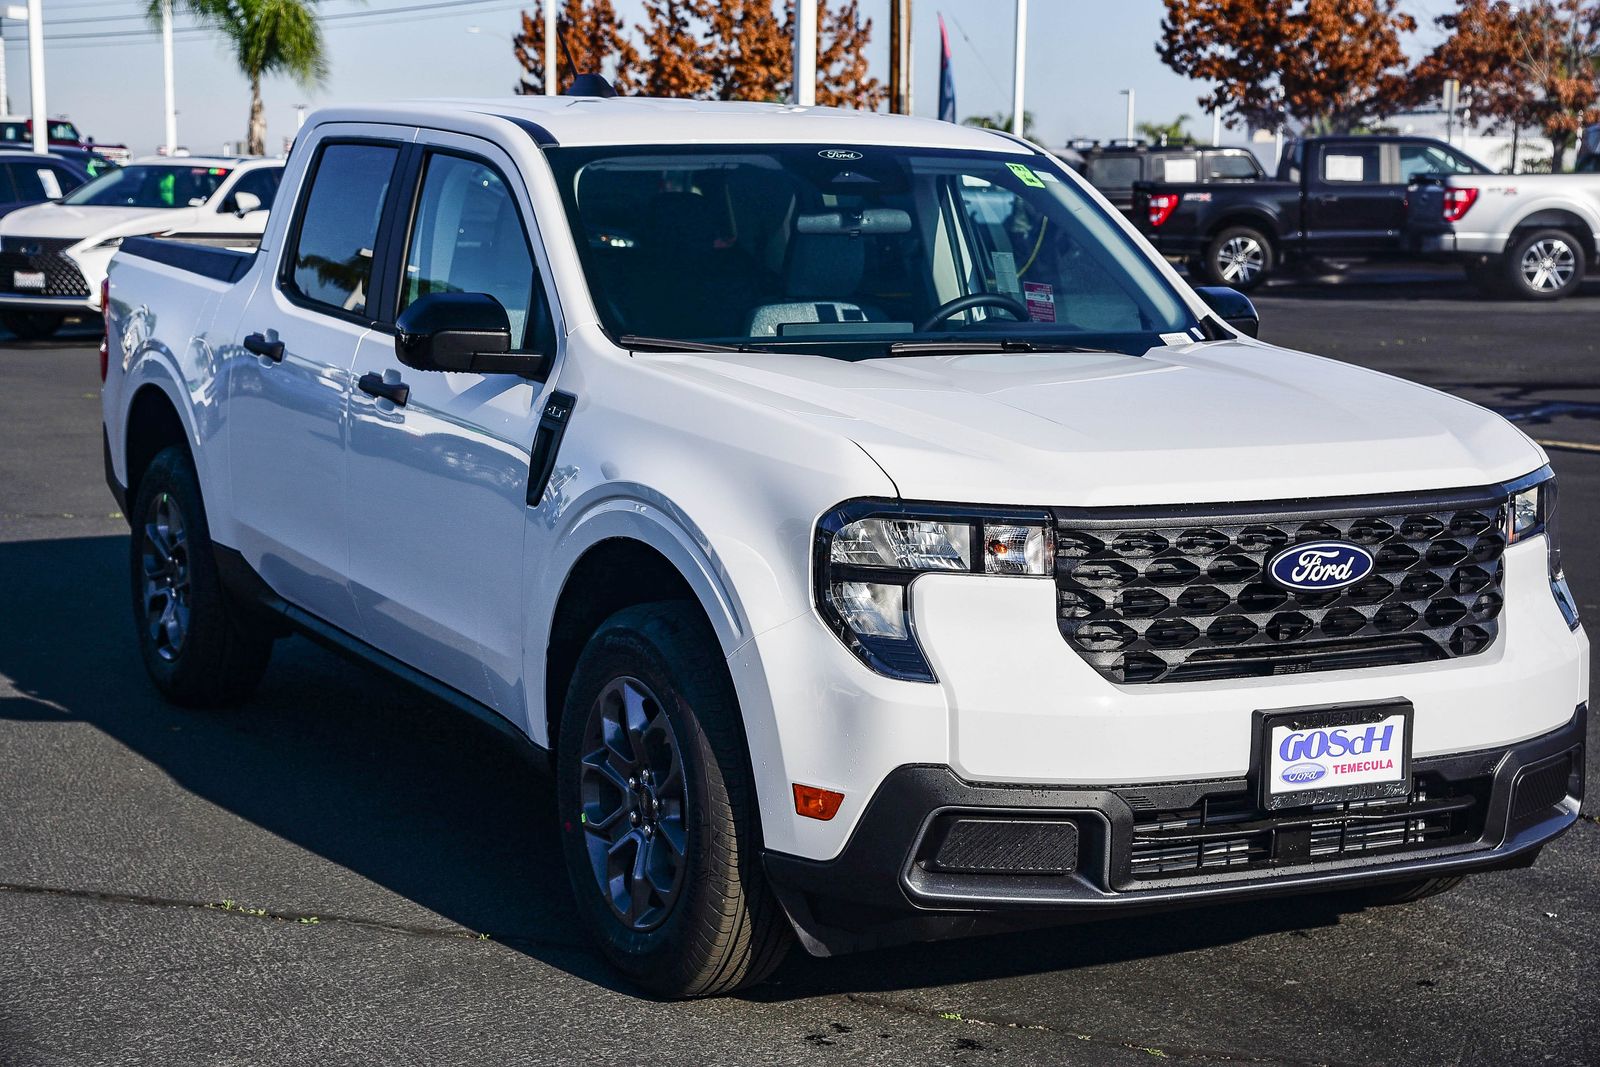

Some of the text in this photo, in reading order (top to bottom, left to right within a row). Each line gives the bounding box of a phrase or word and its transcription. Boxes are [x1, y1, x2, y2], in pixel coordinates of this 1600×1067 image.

[827, 151, 855, 159] Ford
[1291, 550, 1355, 582] Ford
[1333, 759, 1393, 775] TEMECULA
[1289, 770, 1318, 782] Ford
